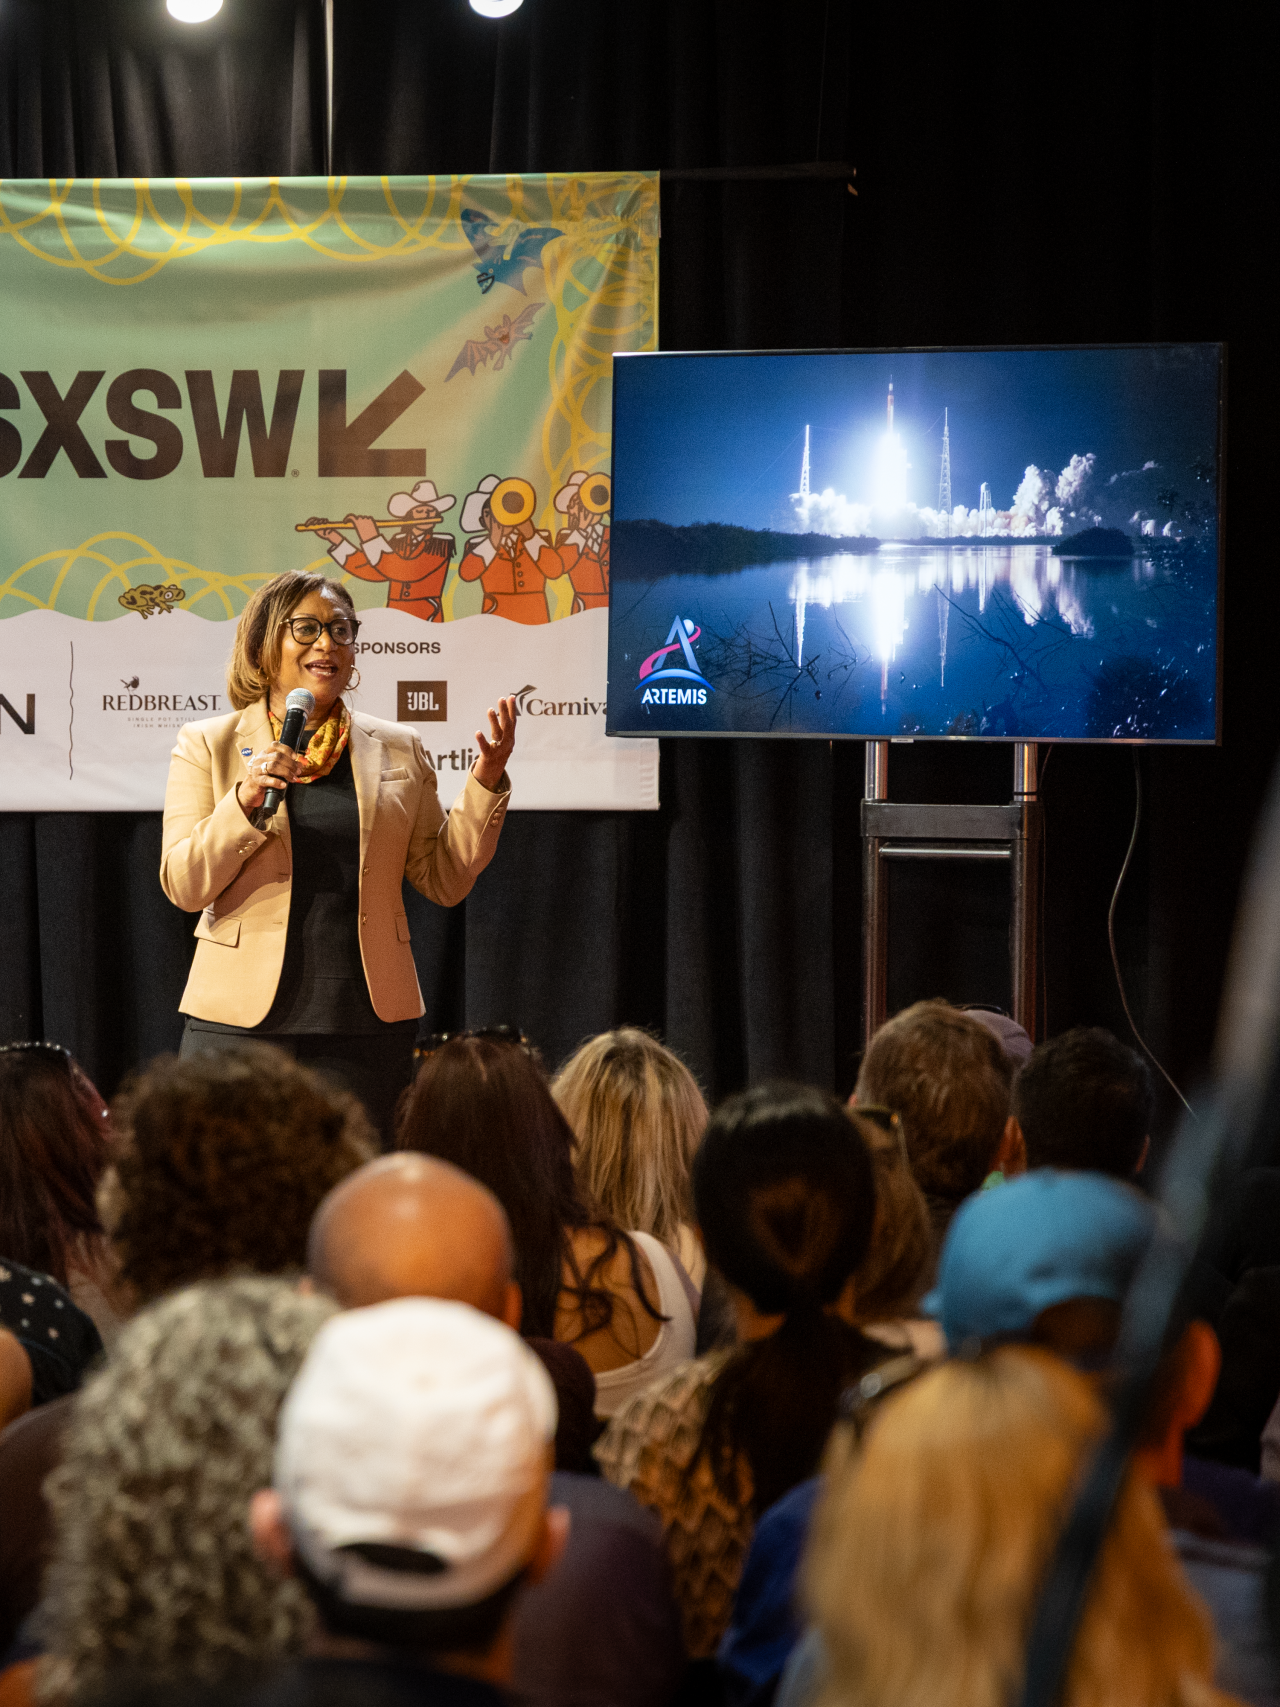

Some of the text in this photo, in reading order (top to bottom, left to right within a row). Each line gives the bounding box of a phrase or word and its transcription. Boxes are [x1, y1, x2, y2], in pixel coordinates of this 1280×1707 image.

[102, 694, 222, 711] REDBREAST
[407, 691, 440, 711] JBL
[641, 688, 708, 705] ARTEMIS
[526, 697, 607, 716] Carniv
[425, 747, 480, 771] rtli
